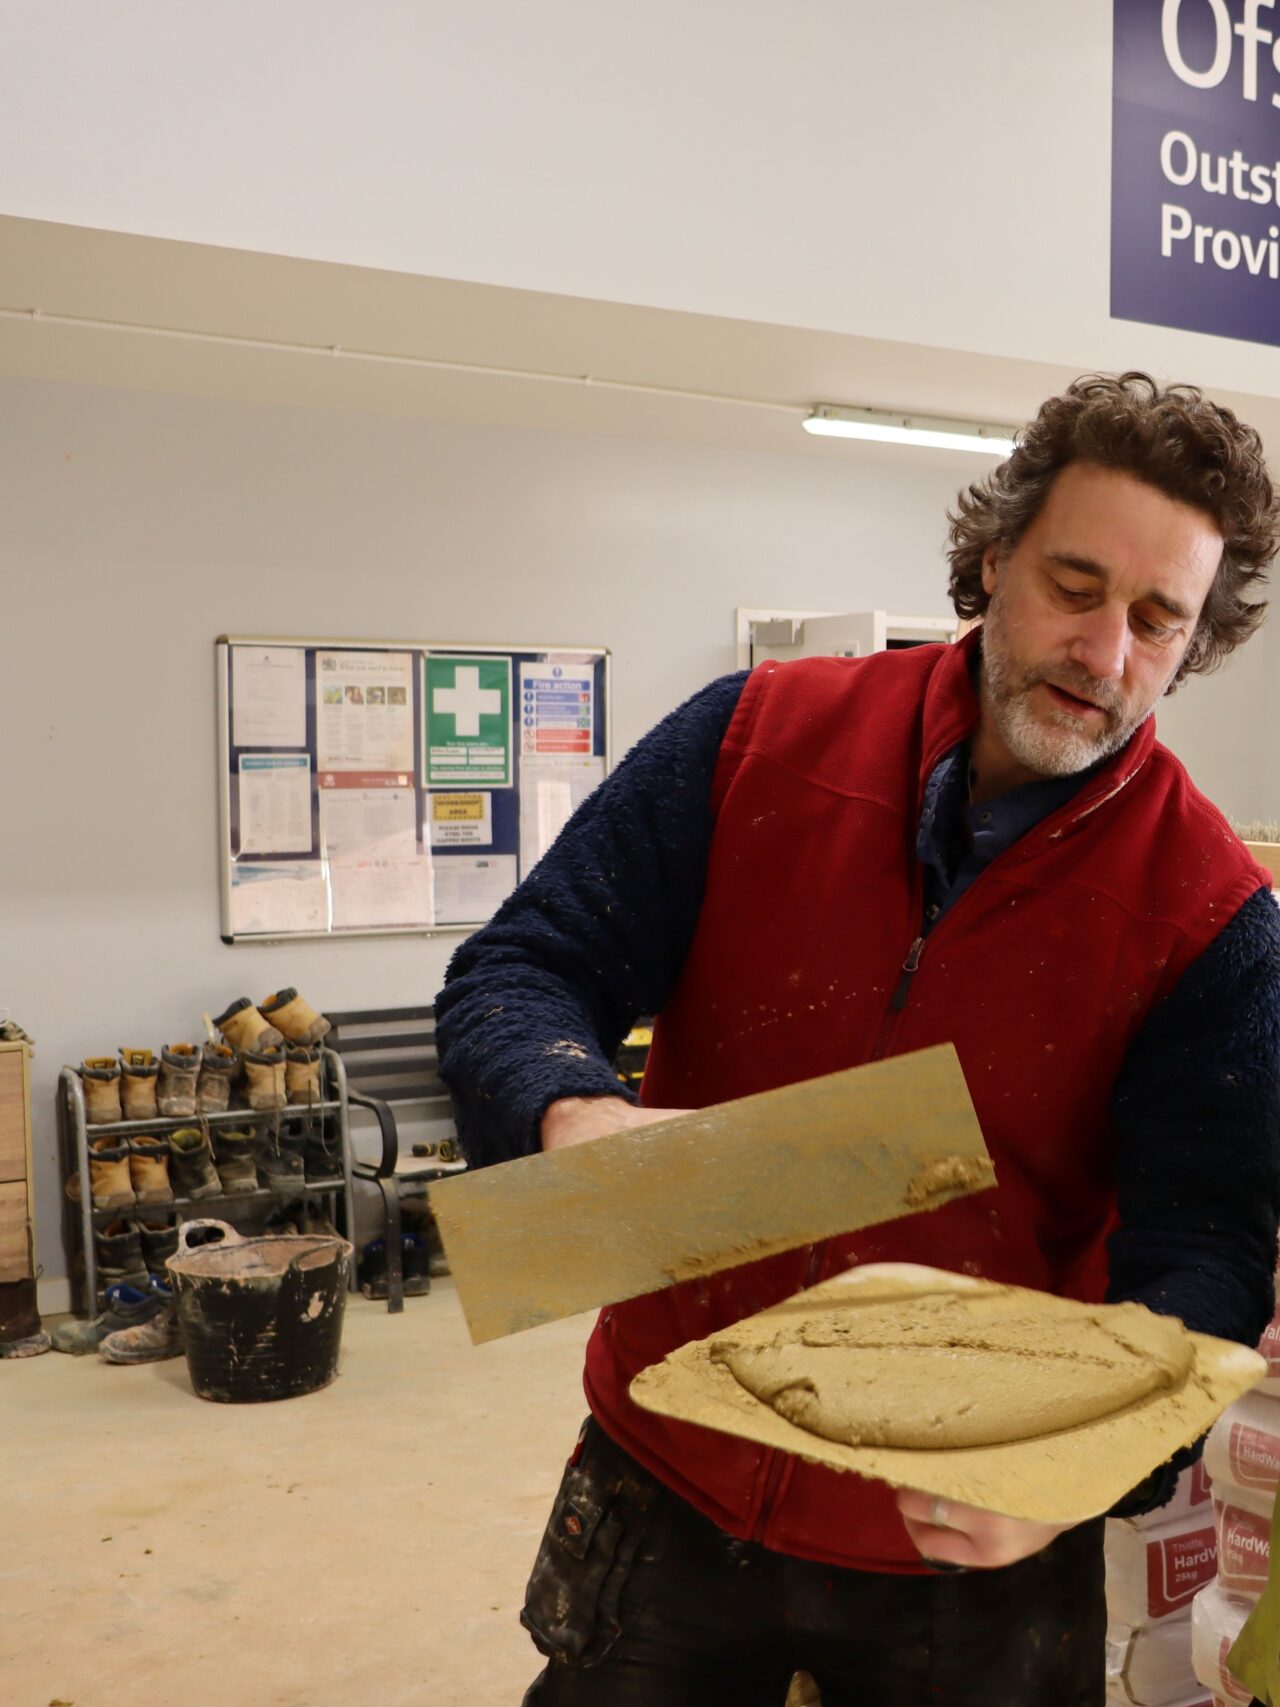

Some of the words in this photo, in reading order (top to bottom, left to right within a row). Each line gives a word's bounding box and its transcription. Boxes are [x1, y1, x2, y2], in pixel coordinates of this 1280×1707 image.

[533, 680, 551, 690] Fire
[552, 680, 582, 690] action
[1173, 1538, 1204, 1551] Thistle
